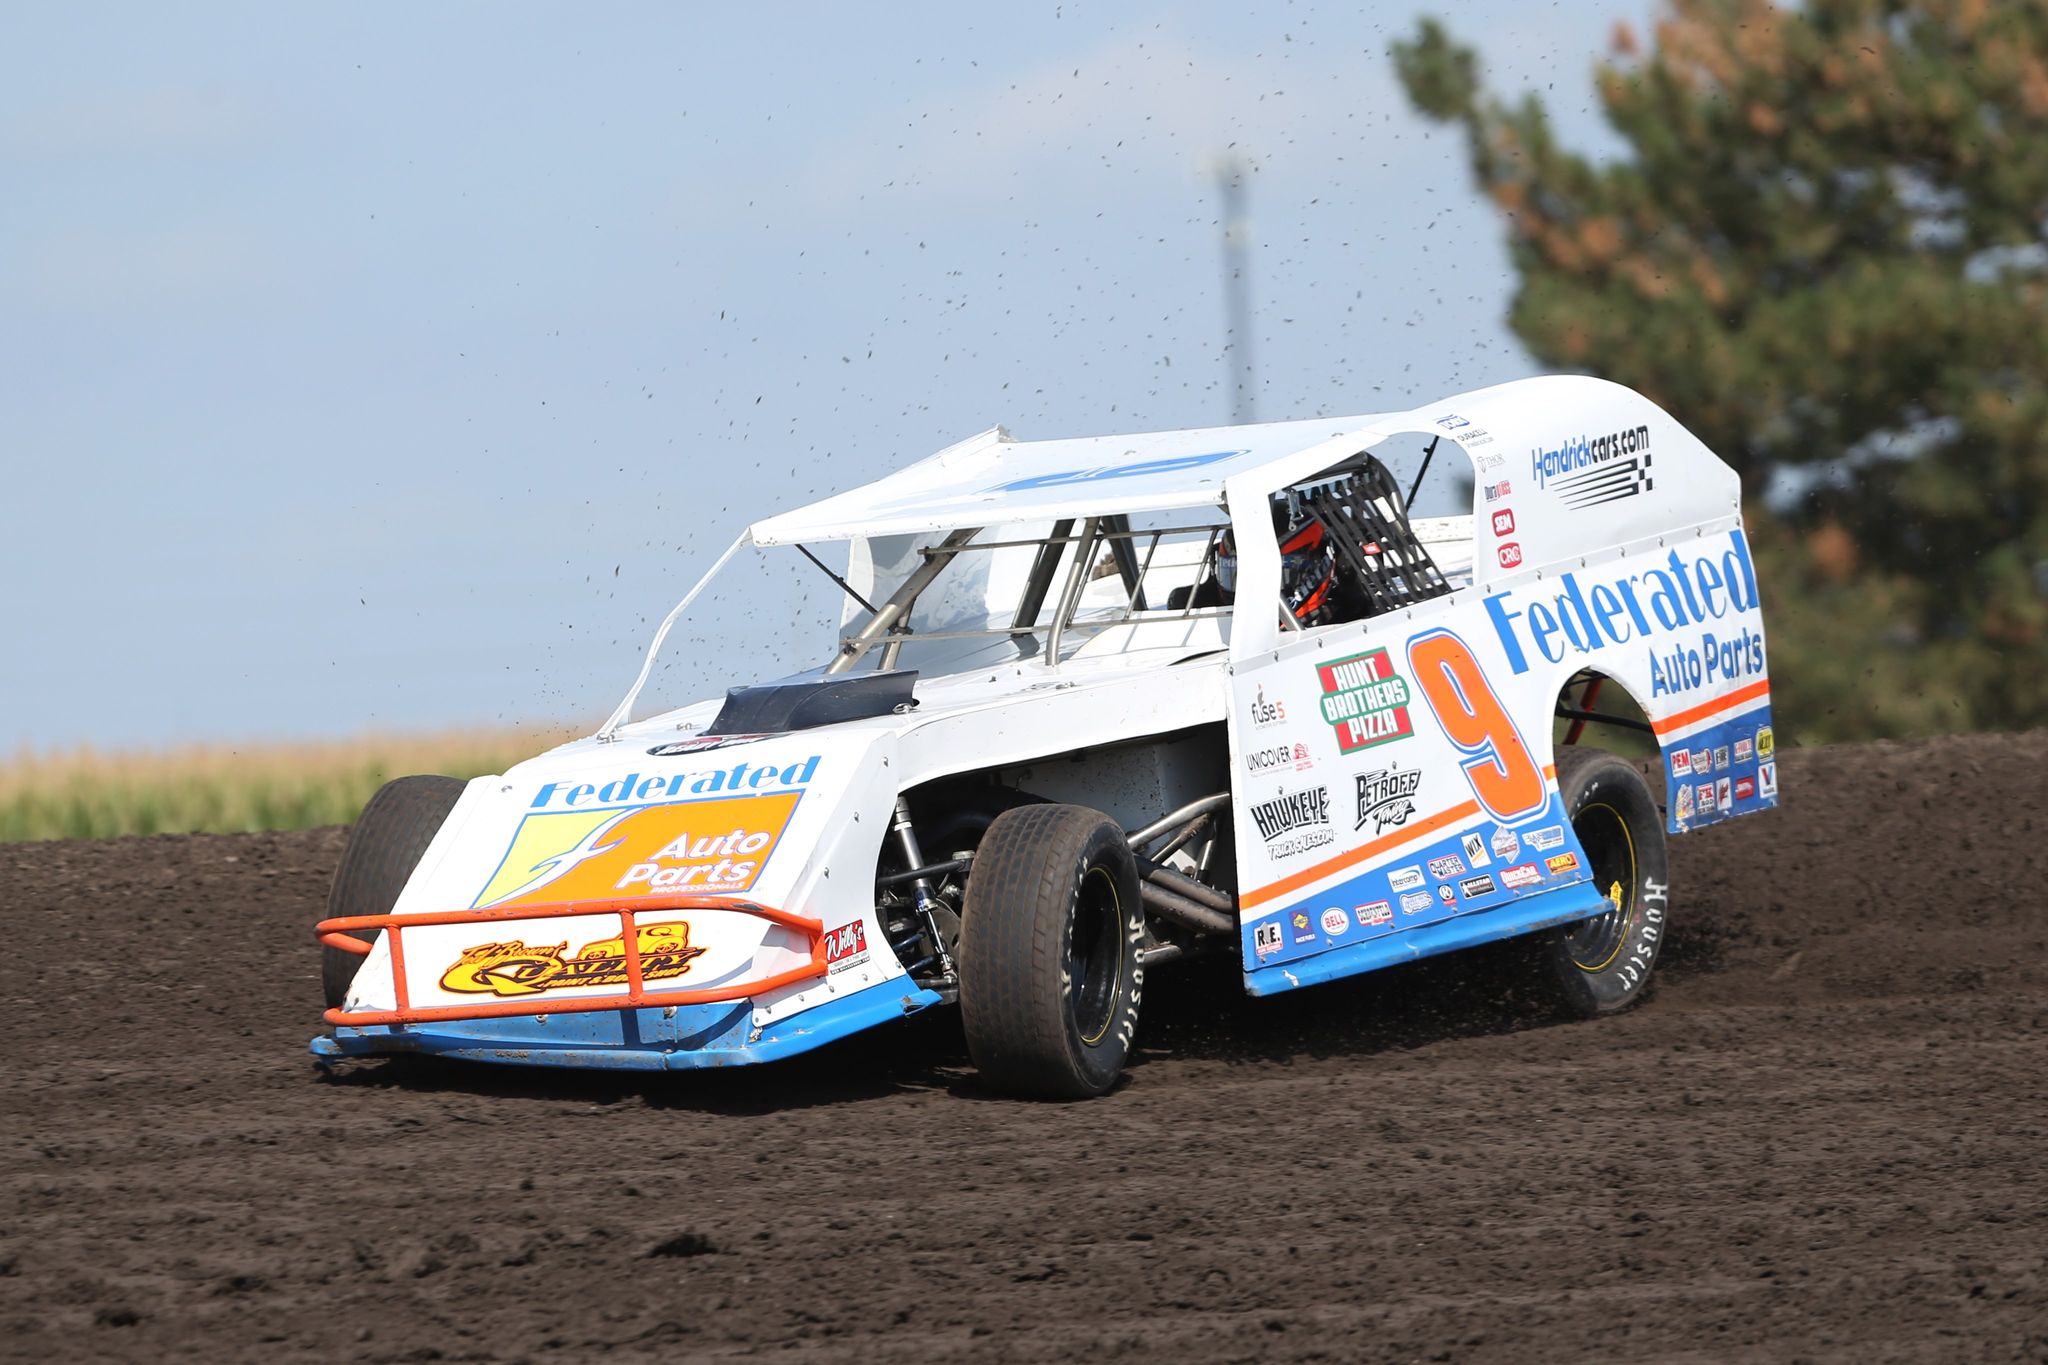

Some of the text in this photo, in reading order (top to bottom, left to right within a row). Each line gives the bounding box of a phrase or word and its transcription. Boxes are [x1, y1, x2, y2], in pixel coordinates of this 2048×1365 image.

[1532, 425, 1650, 490] Hendrickcars.com
[1500, 546, 1520, 565] CRC
[1482, 529, 1760, 675] Federated
[1331, 657, 1380, 691] HUNT
[1648, 627, 1763, 698] Auto Parts
[1323, 679, 1407, 722] BROTHERS
[1347, 708, 1399, 744] PIZZA
[1406, 627, 1547, 825] 9
[1246, 745, 1291, 771] UNICOVER
[1671, 751, 1690, 769] PEM
[530, 756, 822, 808] Federated
[1250, 786, 1328, 841] HAWKEYE
[1354, 769, 1421, 831] PETROFF
[648, 829, 770, 861] Auto
[1465, 834, 1482, 858] WIX
[1550, 853, 1573, 869] AERO
[614, 858, 756, 889] Parts
[650, 881, 745, 894] PROFESSIONALS
[1325, 914, 1345, 928] BELL
[825, 923, 863, 961] Willy's
[544, 967, 688, 988] PAINT & BOD SHOP
